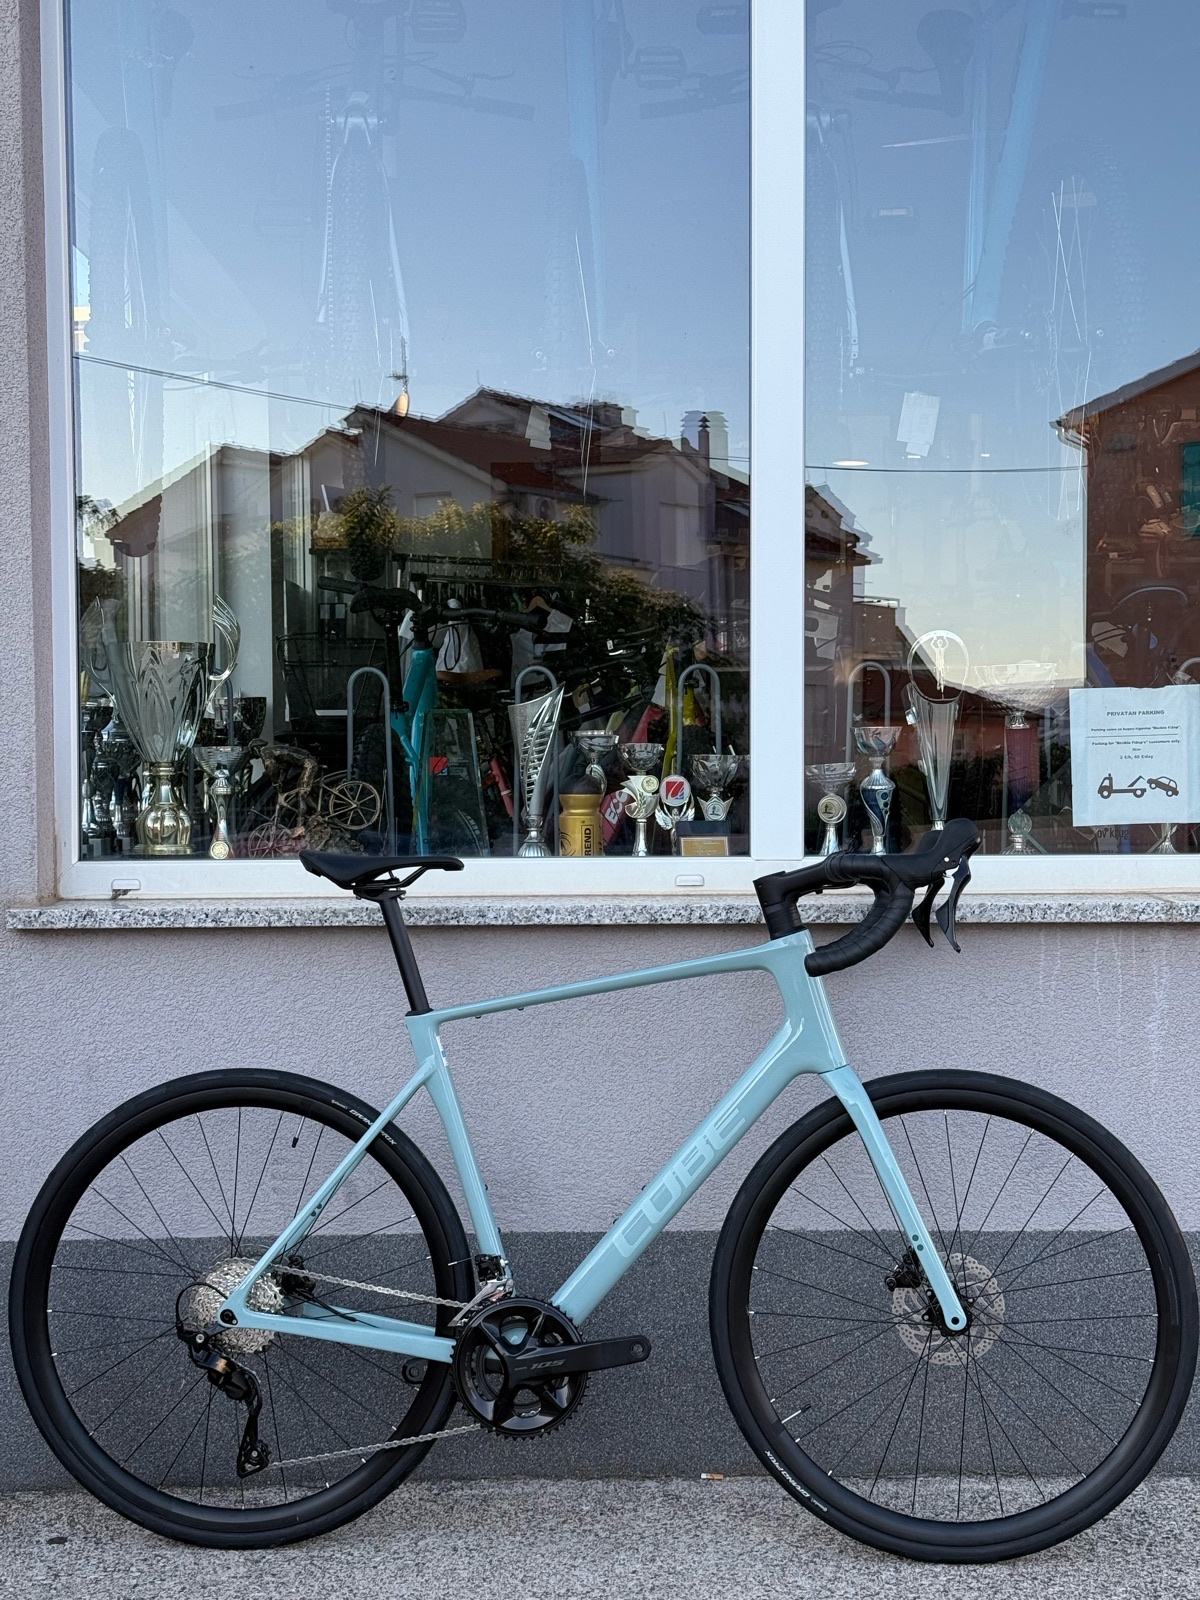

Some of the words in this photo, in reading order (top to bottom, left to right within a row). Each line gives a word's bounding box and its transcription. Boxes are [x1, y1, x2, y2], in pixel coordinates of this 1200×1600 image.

[349, 1109, 375, 1127] GRAN
[611, 1099, 746, 1258] CUBE
[529, 1358, 567, 1371] 105
